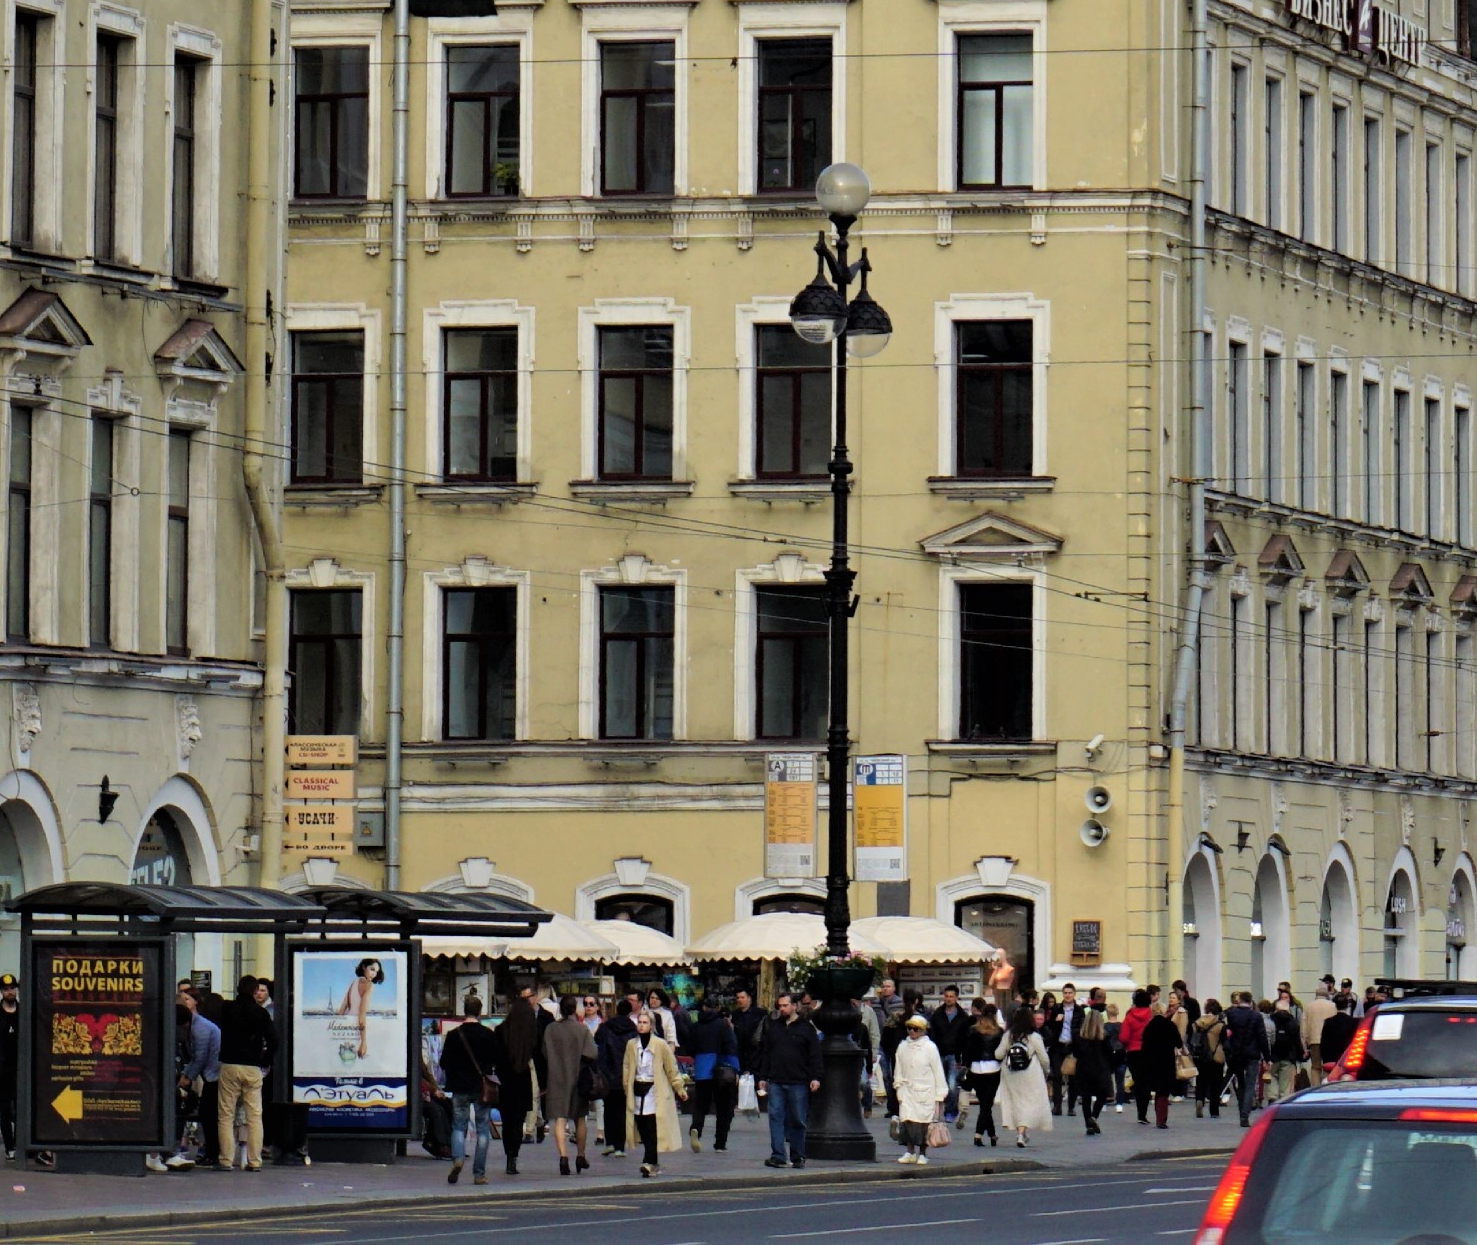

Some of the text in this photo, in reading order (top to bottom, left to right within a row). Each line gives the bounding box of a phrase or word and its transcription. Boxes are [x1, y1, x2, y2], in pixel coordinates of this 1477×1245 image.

[1378, 7, 1427, 68] ЦЕНТР
[298, 813, 335, 825] УСАЧИ
[52, 959, 143, 976] ПОДАРКИ
[51, 977, 144, 992] SOUVENIRS
